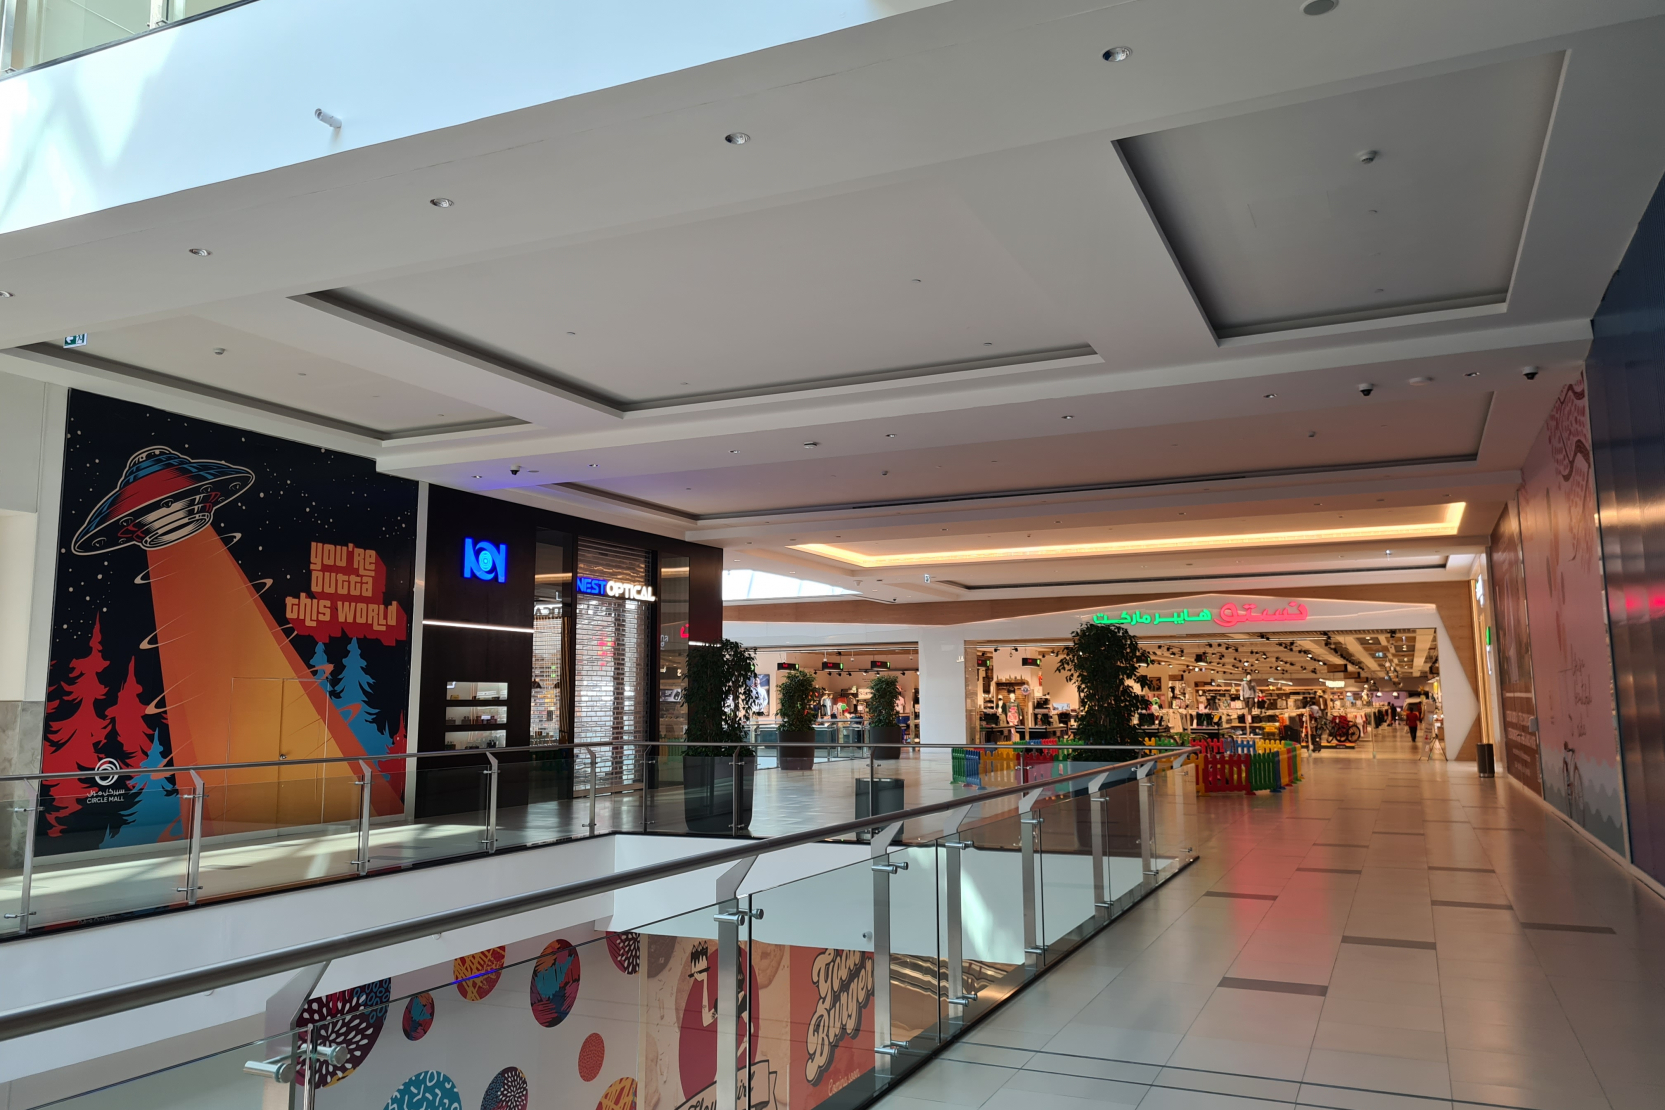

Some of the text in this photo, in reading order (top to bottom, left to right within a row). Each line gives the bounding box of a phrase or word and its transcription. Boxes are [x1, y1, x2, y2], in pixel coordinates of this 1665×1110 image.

[577, 577, 656, 601] NEST OPTICAL
[1093, 601, 1308, 628] نستو هايبر ماركت
[108, 795, 125, 803] MALL
